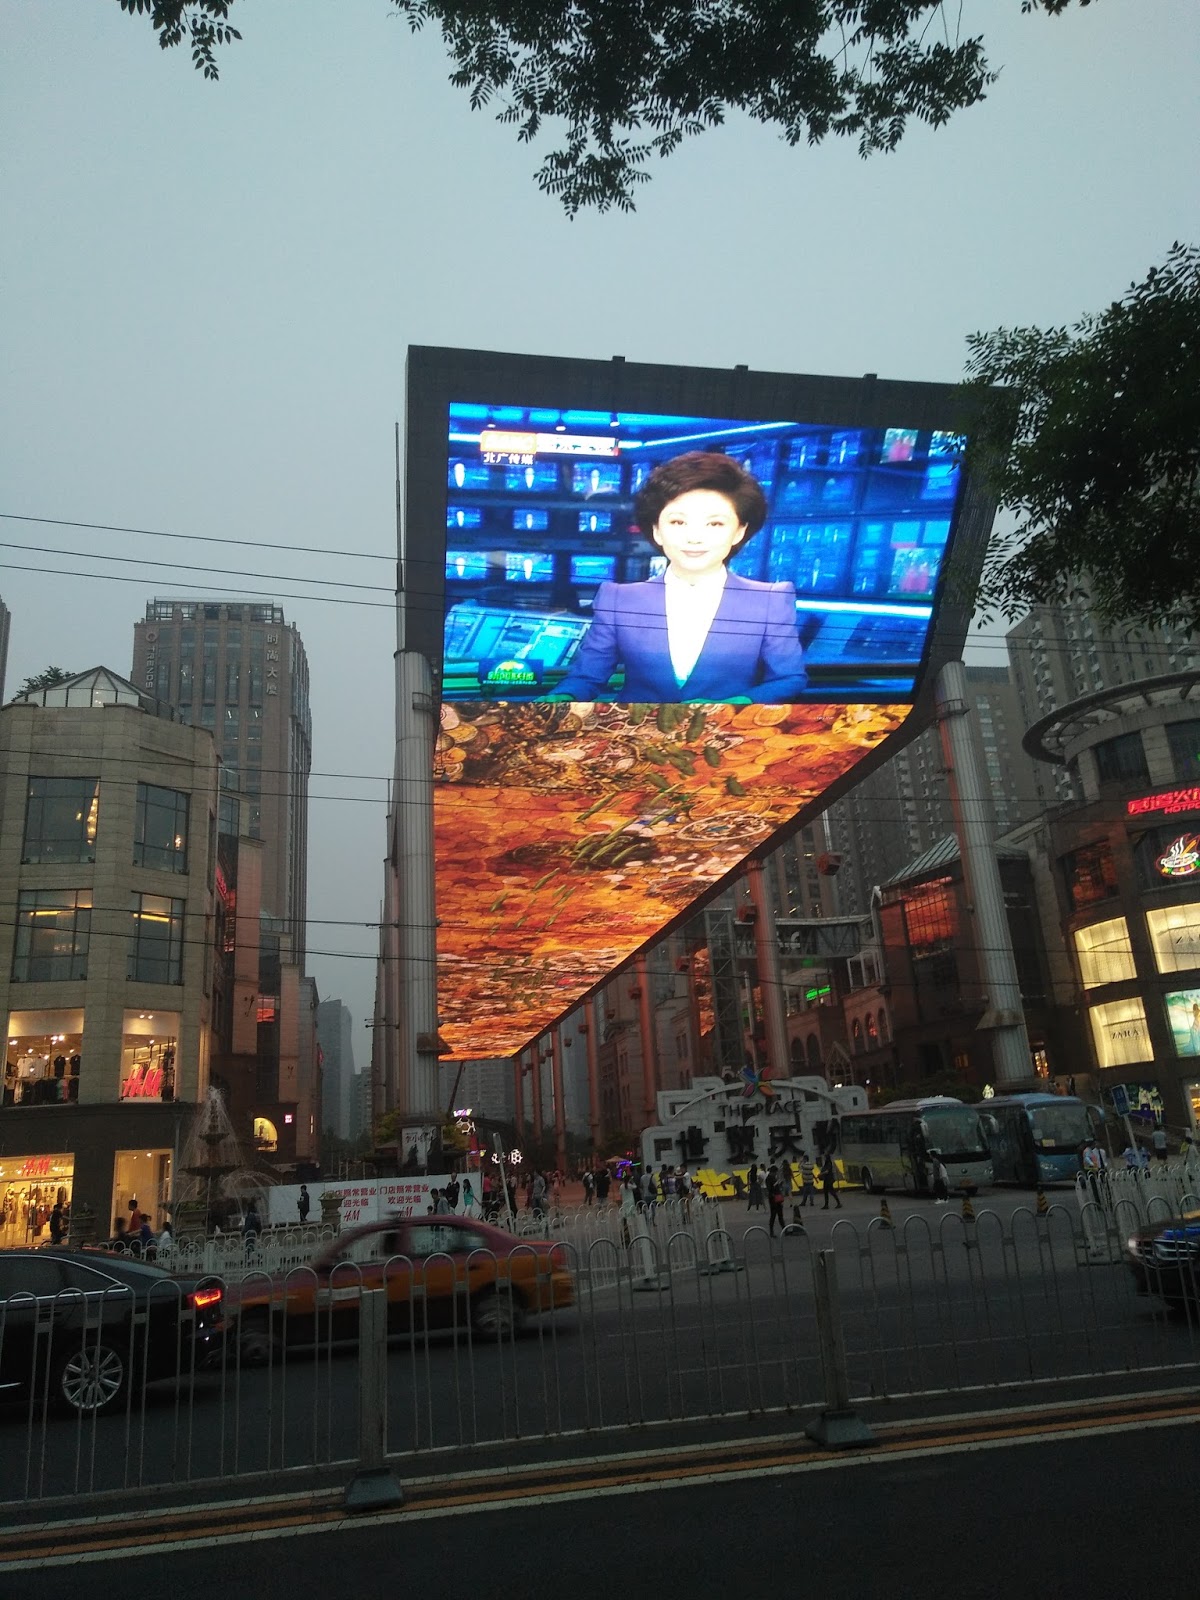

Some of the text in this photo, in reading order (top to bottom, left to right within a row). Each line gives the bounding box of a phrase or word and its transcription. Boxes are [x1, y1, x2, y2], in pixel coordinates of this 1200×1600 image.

[483, 452, 534, 465] 北广传媒
[145, 645, 157, 688] TRENDS
[266, 632, 279, 695] 时尚大厦
[1111, 1029, 1140, 1040] ZARA
[719, 1100, 803, 1117] THE PLACE
[22, 1155, 51, 1177] H&M
[336, 1187, 377, 1197] 店照常营业
[380, 1184, 429, 1195] 门店照常营业
[343, 1198, 369, 1207] 迎光临
[387, 1195, 421, 1204] 欢迎光临
[343, 1209, 361, 1222] H&M
